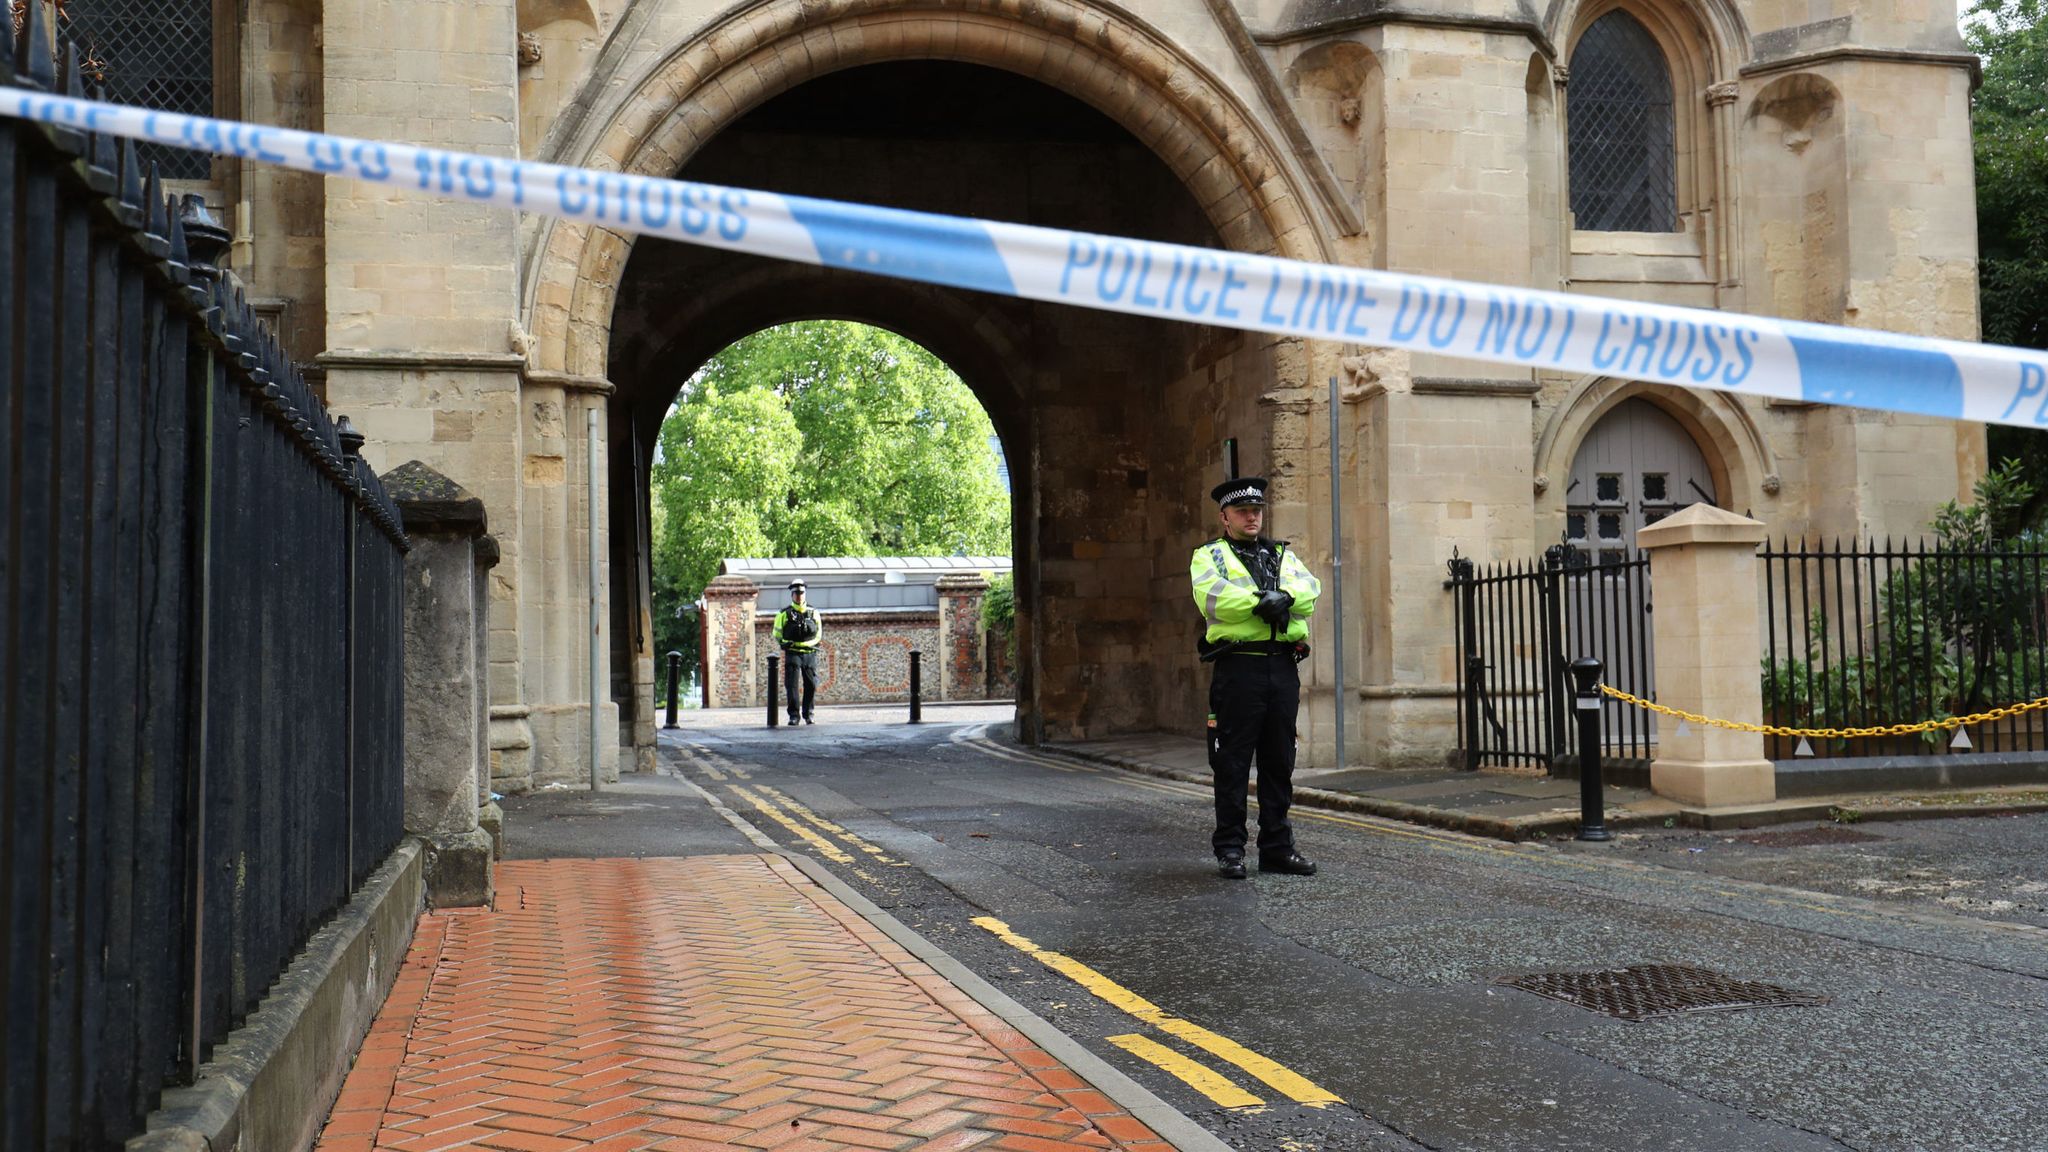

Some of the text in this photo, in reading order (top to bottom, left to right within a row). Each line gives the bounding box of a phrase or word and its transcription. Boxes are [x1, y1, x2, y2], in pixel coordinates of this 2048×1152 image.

[556, 169, 749, 241] CROSS
[1059, 237, 1760, 387] POLICE LINE DO NOT CROSS
